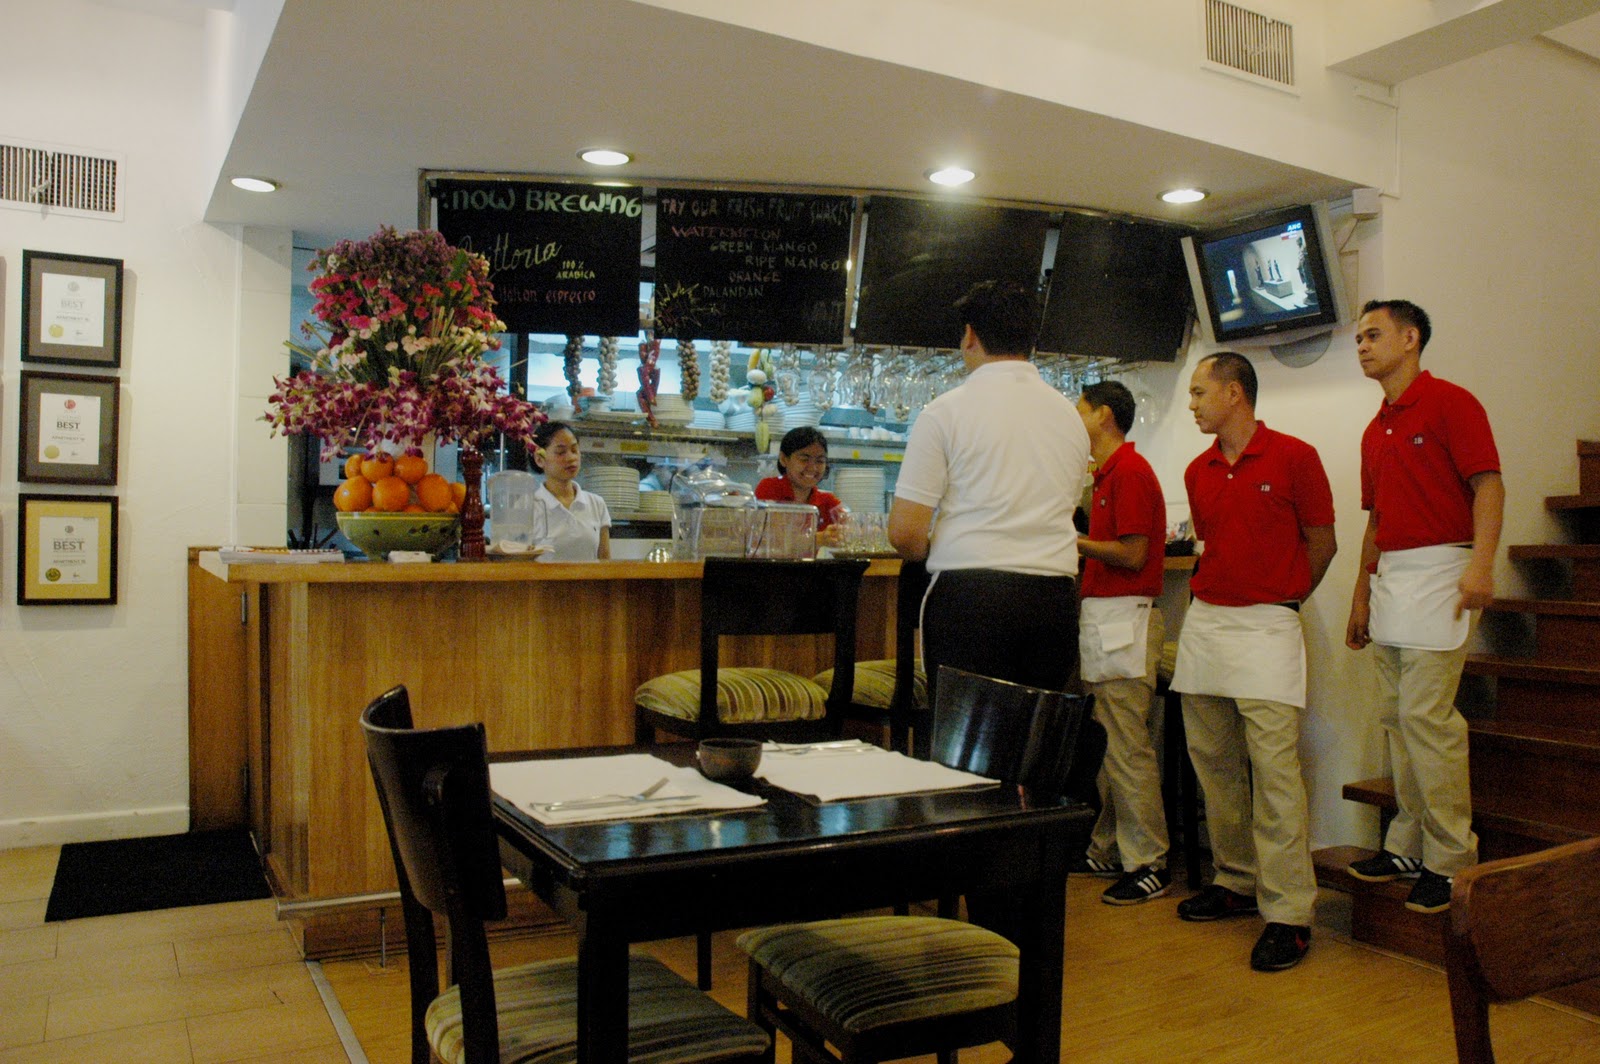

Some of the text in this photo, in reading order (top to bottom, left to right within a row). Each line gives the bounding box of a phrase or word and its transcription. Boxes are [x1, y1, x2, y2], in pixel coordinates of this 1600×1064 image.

[661, 198, 686, 217] TRY
[691, 198, 718, 218] OUR
[671, 224, 782, 241] WATERMELON
[709, 240, 819, 254] GREEN MANGO
[744, 255, 777, 270] RIPE
[555, 270, 596, 280] ARABICA
[728, 270, 782, 284] ORANGE
[56, 421, 80, 430] BEST
[53, 541, 84, 550] BEST
